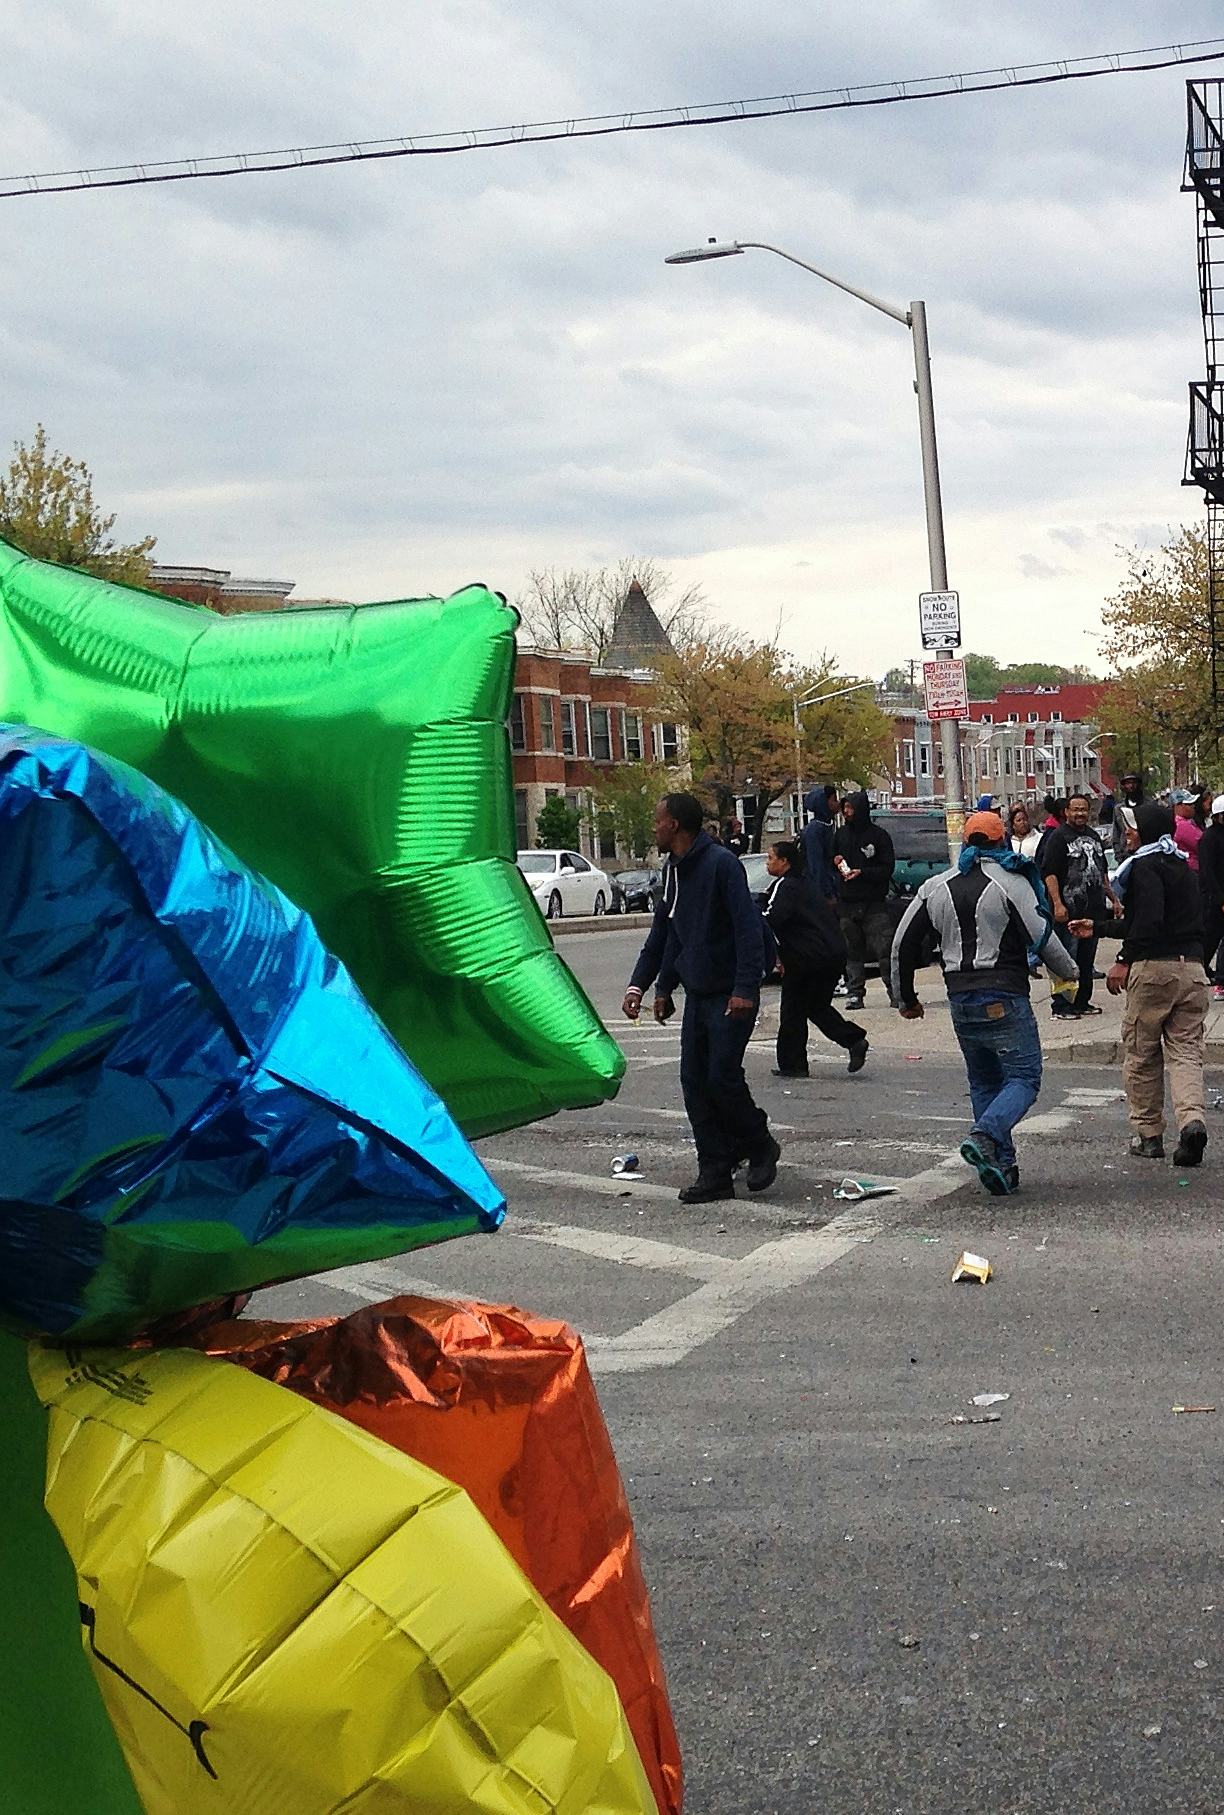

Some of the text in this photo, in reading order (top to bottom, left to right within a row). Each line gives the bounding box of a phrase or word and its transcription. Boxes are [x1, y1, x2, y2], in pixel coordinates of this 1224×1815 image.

[932, 603, 947, 612] NO
[923, 612, 956, 620] PARKING
[924, 664, 935, 673] NO
